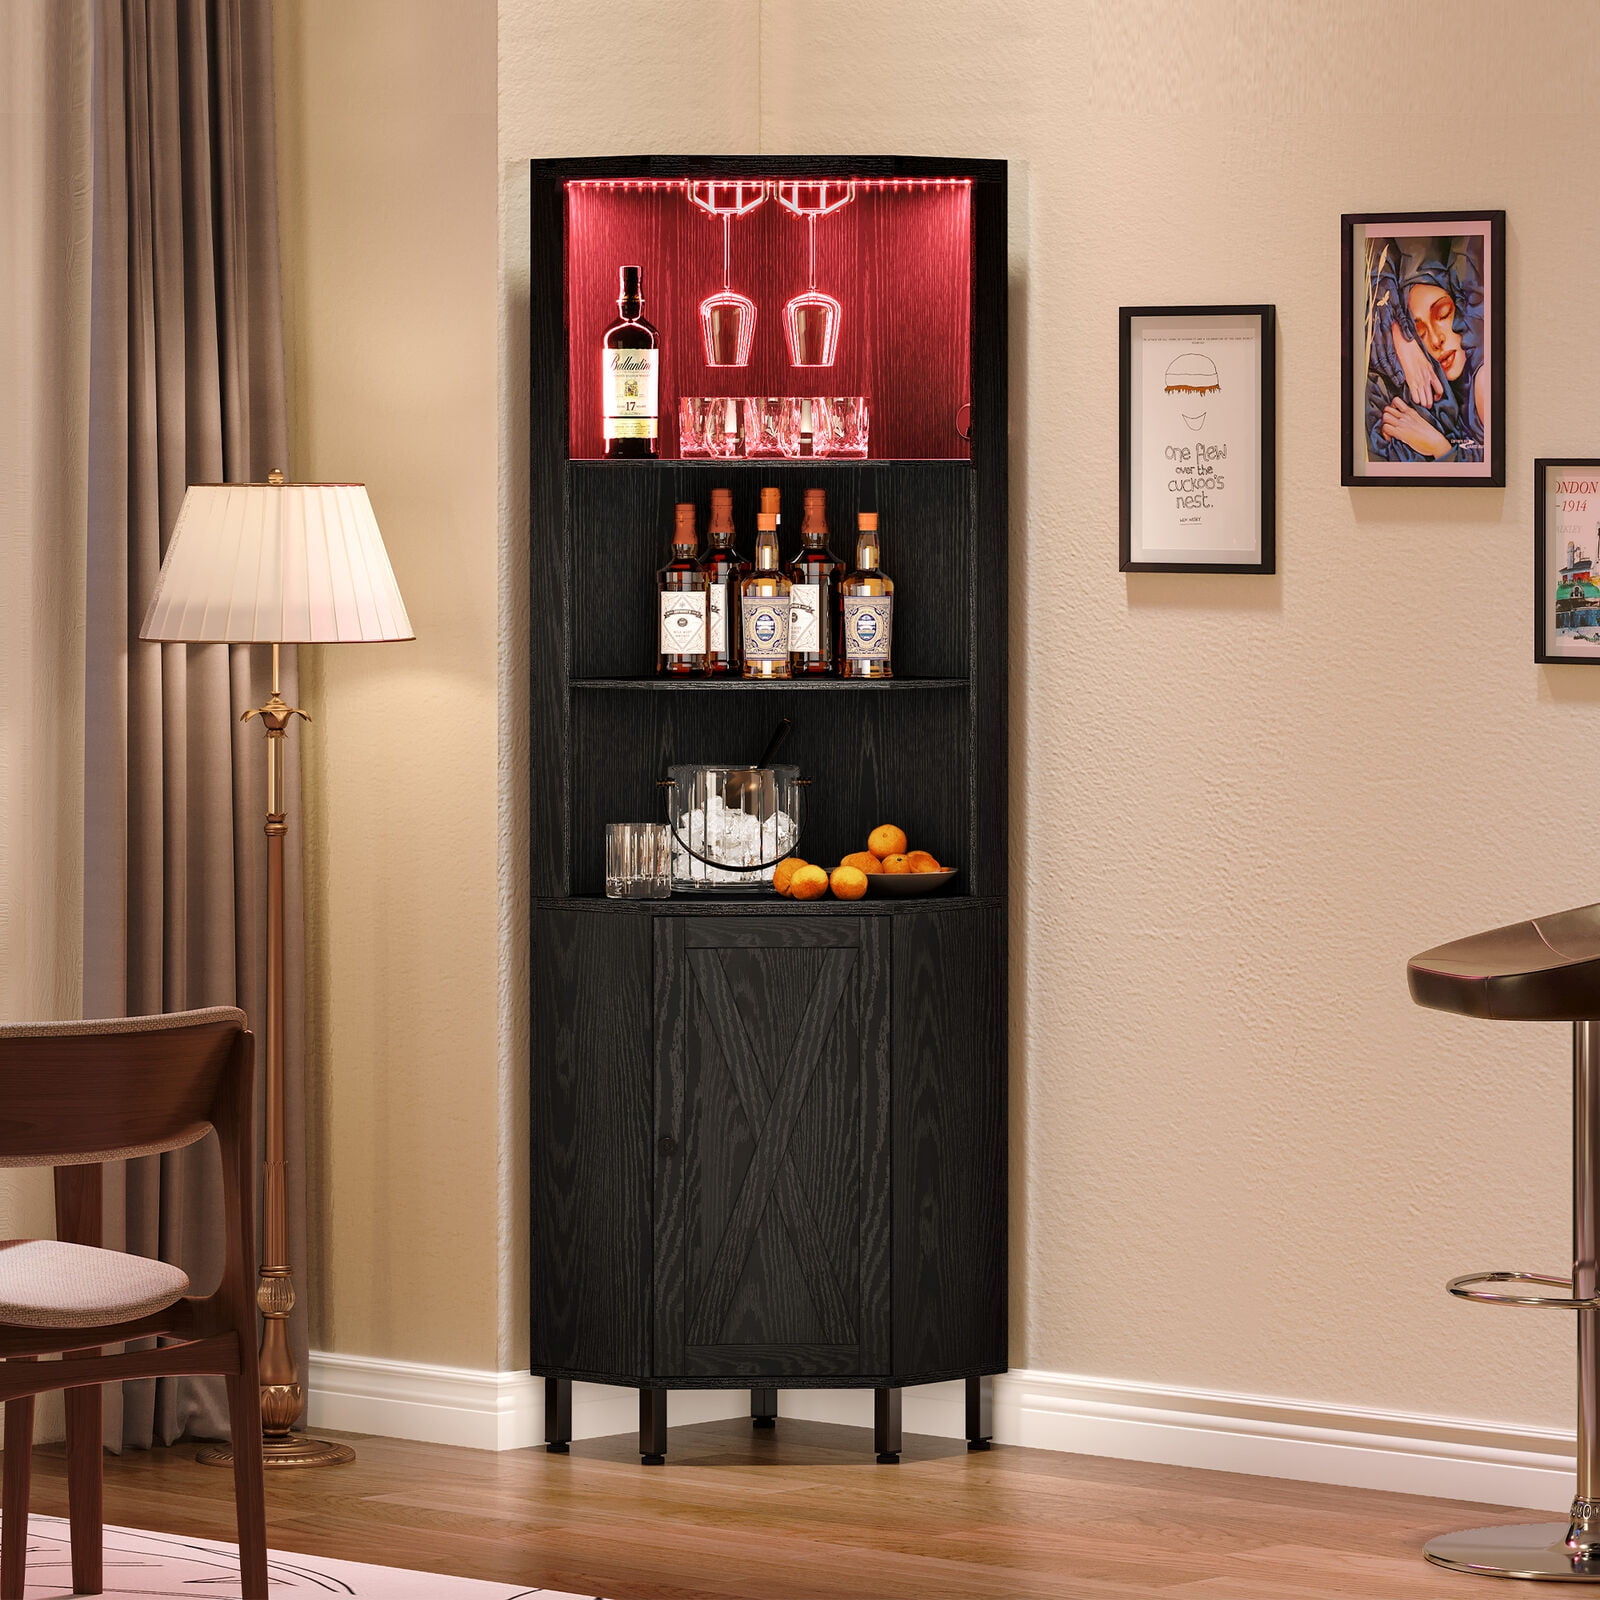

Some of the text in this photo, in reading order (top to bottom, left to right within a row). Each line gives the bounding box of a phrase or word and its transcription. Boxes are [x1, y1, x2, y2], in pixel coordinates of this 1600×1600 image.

[625, 401, 636, 411] 17
[1195, 442, 1227, 463] flew
[1175, 464, 1214, 476] over the
[1175, 490, 1214, 509] nest.
